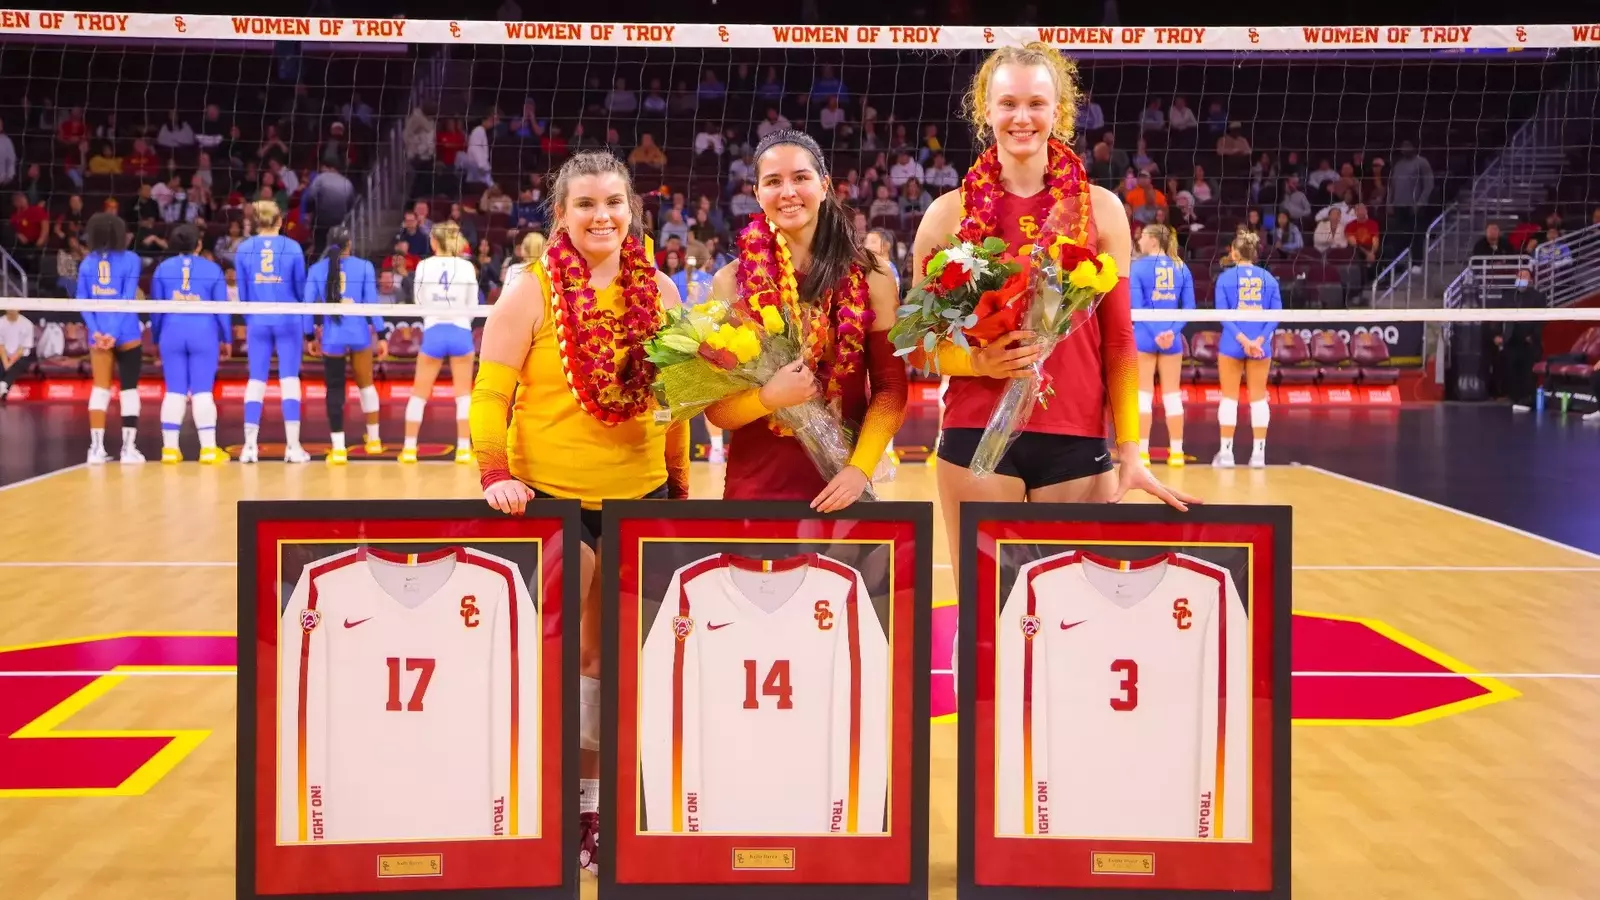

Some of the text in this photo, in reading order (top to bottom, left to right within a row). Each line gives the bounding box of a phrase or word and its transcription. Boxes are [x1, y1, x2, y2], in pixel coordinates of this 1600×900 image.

[0, 11, 129, 31] EN OF TROY
[231, 17, 405, 37] WOMEN OF TROY
[505, 24, 675, 41] WOMEN OF TROY
[772, 27, 940, 43] WOMEN OF TROY
[1038, 28, 1206, 44] WOMEN OF TROY
[1303, 27, 1472, 44] WOMEN OF TROY
[98, 260, 111, 285] 0
[261, 248, 274, 273] 2
[182, 266, 191, 291] 1
[439, 270, 449, 292] 4
[1155, 267, 1175, 291] 21
[1239, 277, 1263, 301] 22
[460, 595, 480, 628] SC
[814, 600, 834, 630] SC
[1172, 598, 1192, 630] SC
[386, 657, 436, 712] 17
[743, 659, 793, 710] 14
[1109, 658, 1138, 712] 3
[687, 792, 698, 813] ON!
[1037, 781, 1048, 803] ON!
[311, 785, 324, 841] IGHT ON!
[831, 799, 844, 833] TROJ
